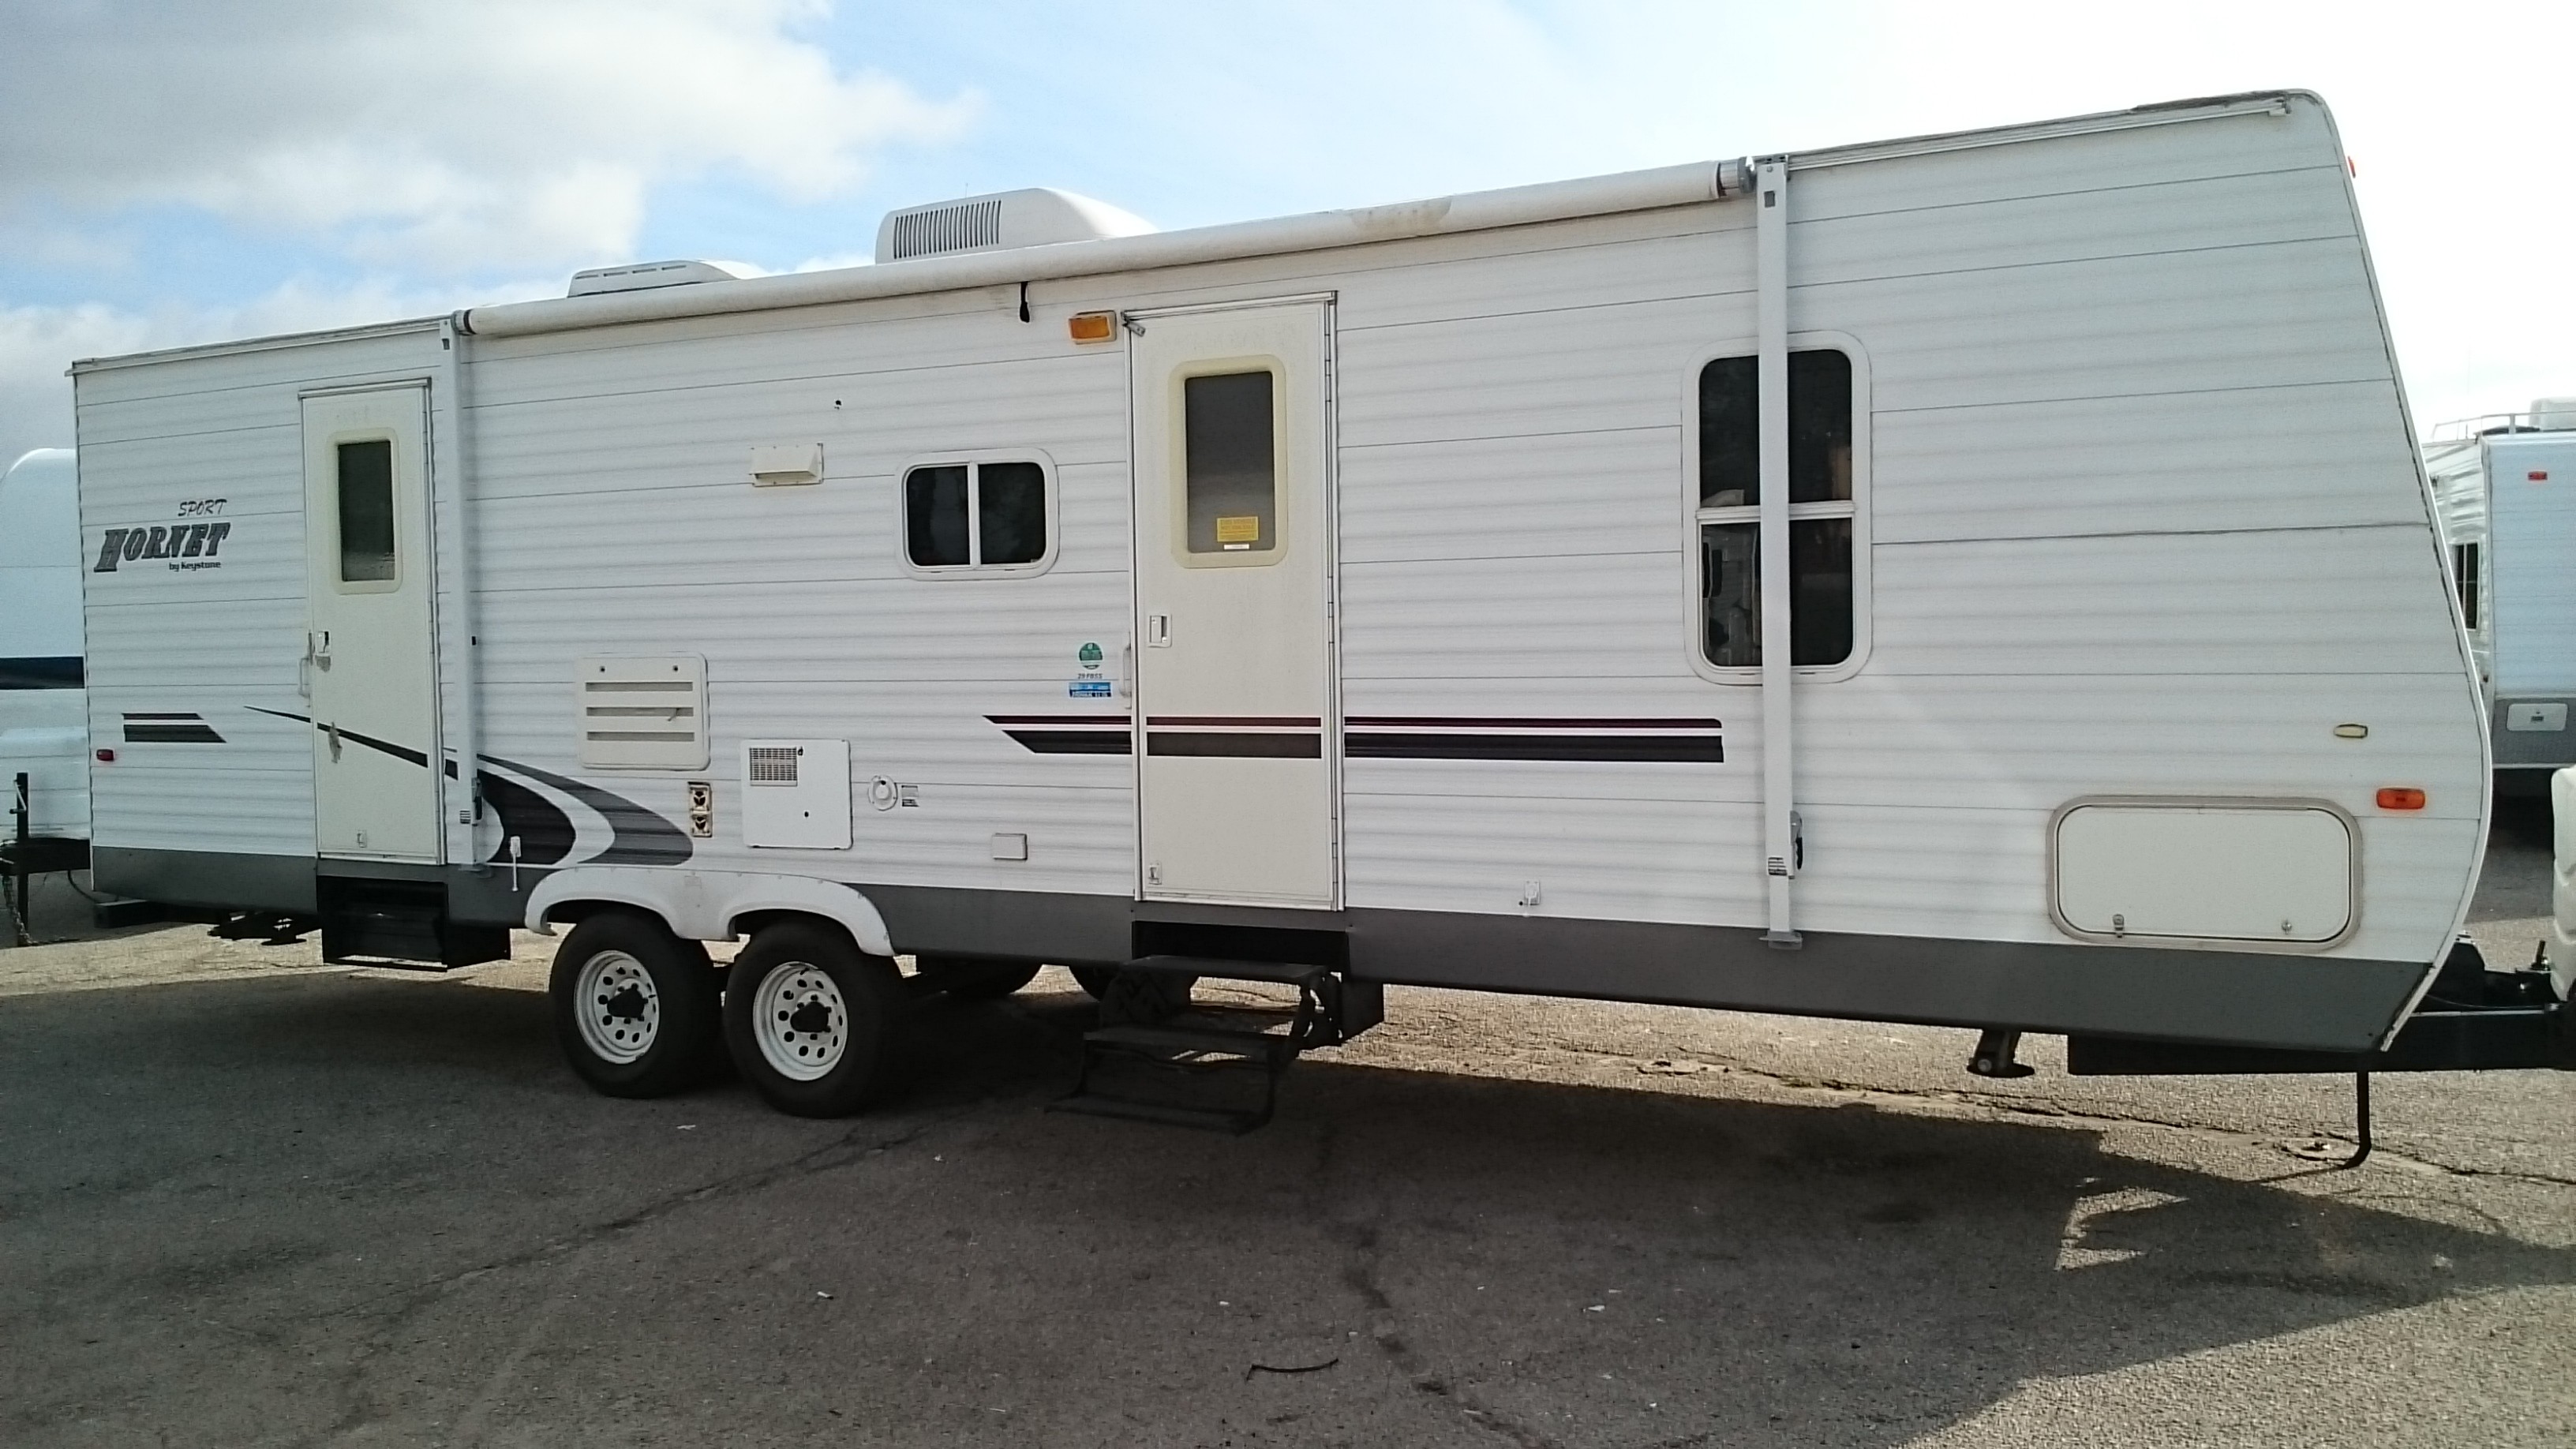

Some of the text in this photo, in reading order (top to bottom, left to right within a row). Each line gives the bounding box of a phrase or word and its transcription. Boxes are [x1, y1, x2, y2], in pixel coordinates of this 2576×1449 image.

[178, 499, 227, 516] SPORT
[94, 522, 230, 572] HORNET
[169, 561, 221, 571] by Keystone
